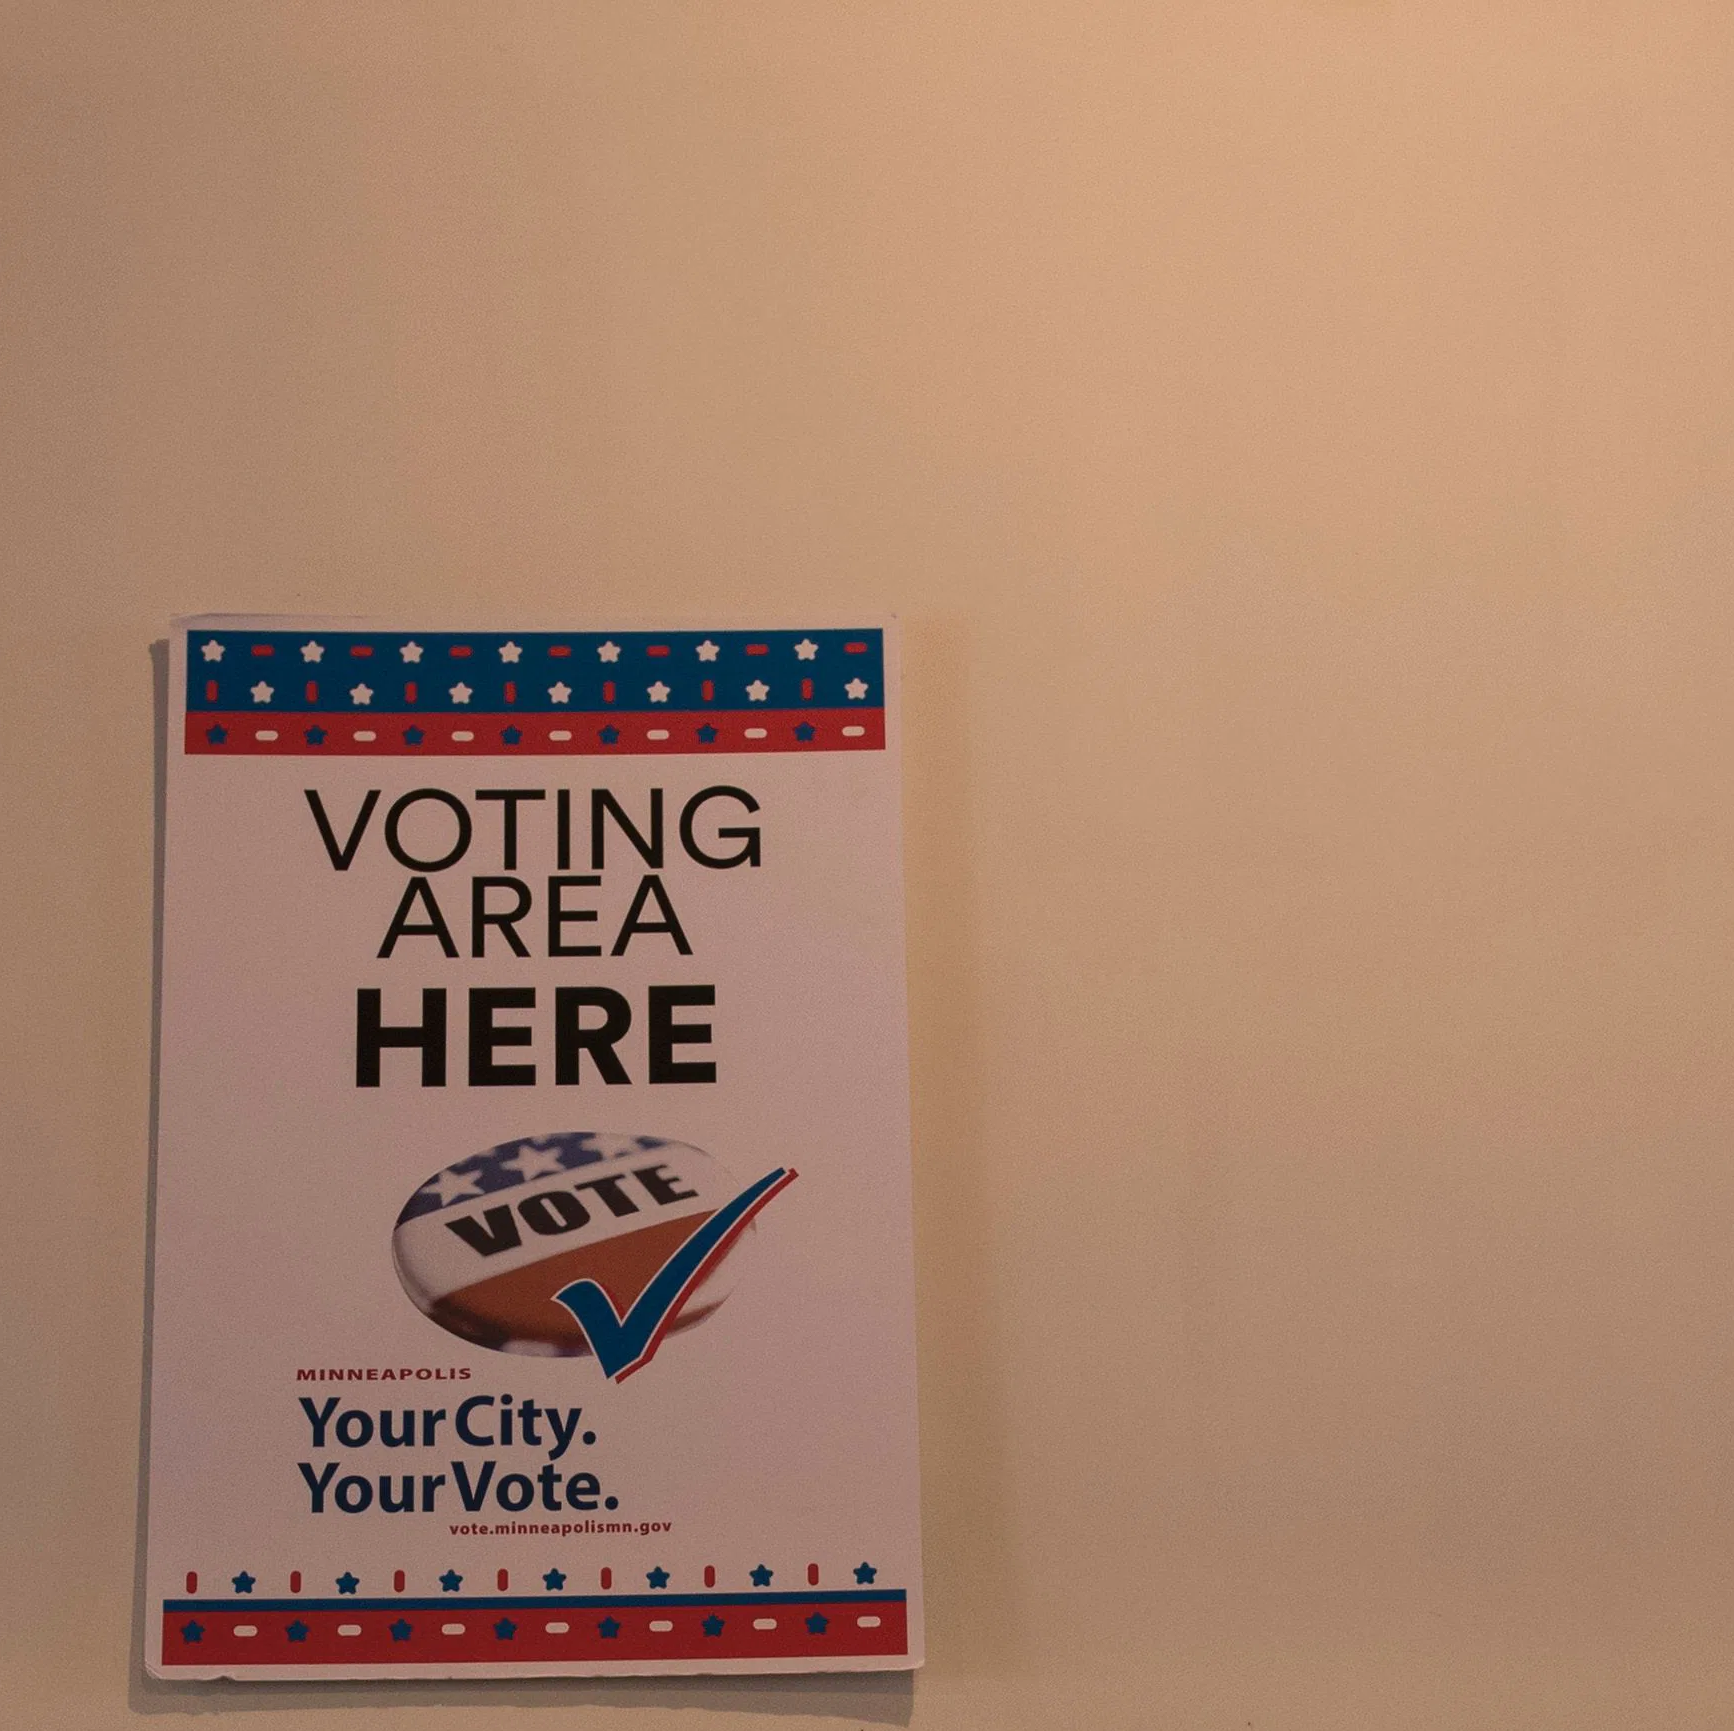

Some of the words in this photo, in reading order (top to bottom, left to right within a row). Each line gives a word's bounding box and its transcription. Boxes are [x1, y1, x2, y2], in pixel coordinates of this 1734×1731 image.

[305, 784, 761, 872] VOTING
[377, 875, 693, 959] AREA
[356, 985, 716, 1087] HERE
[444, 1164, 699, 1258] VOTE
[297, 1368, 472, 1381] MINNEAPOLIS
[299, 1397, 446, 1448] Your
[455, 1394, 596, 1461] City.
[298, 1462, 446, 1514] Your
[451, 1462, 619, 1514] Vote.
[450, 1520, 671, 1536] vote.minneapolismn.gov
